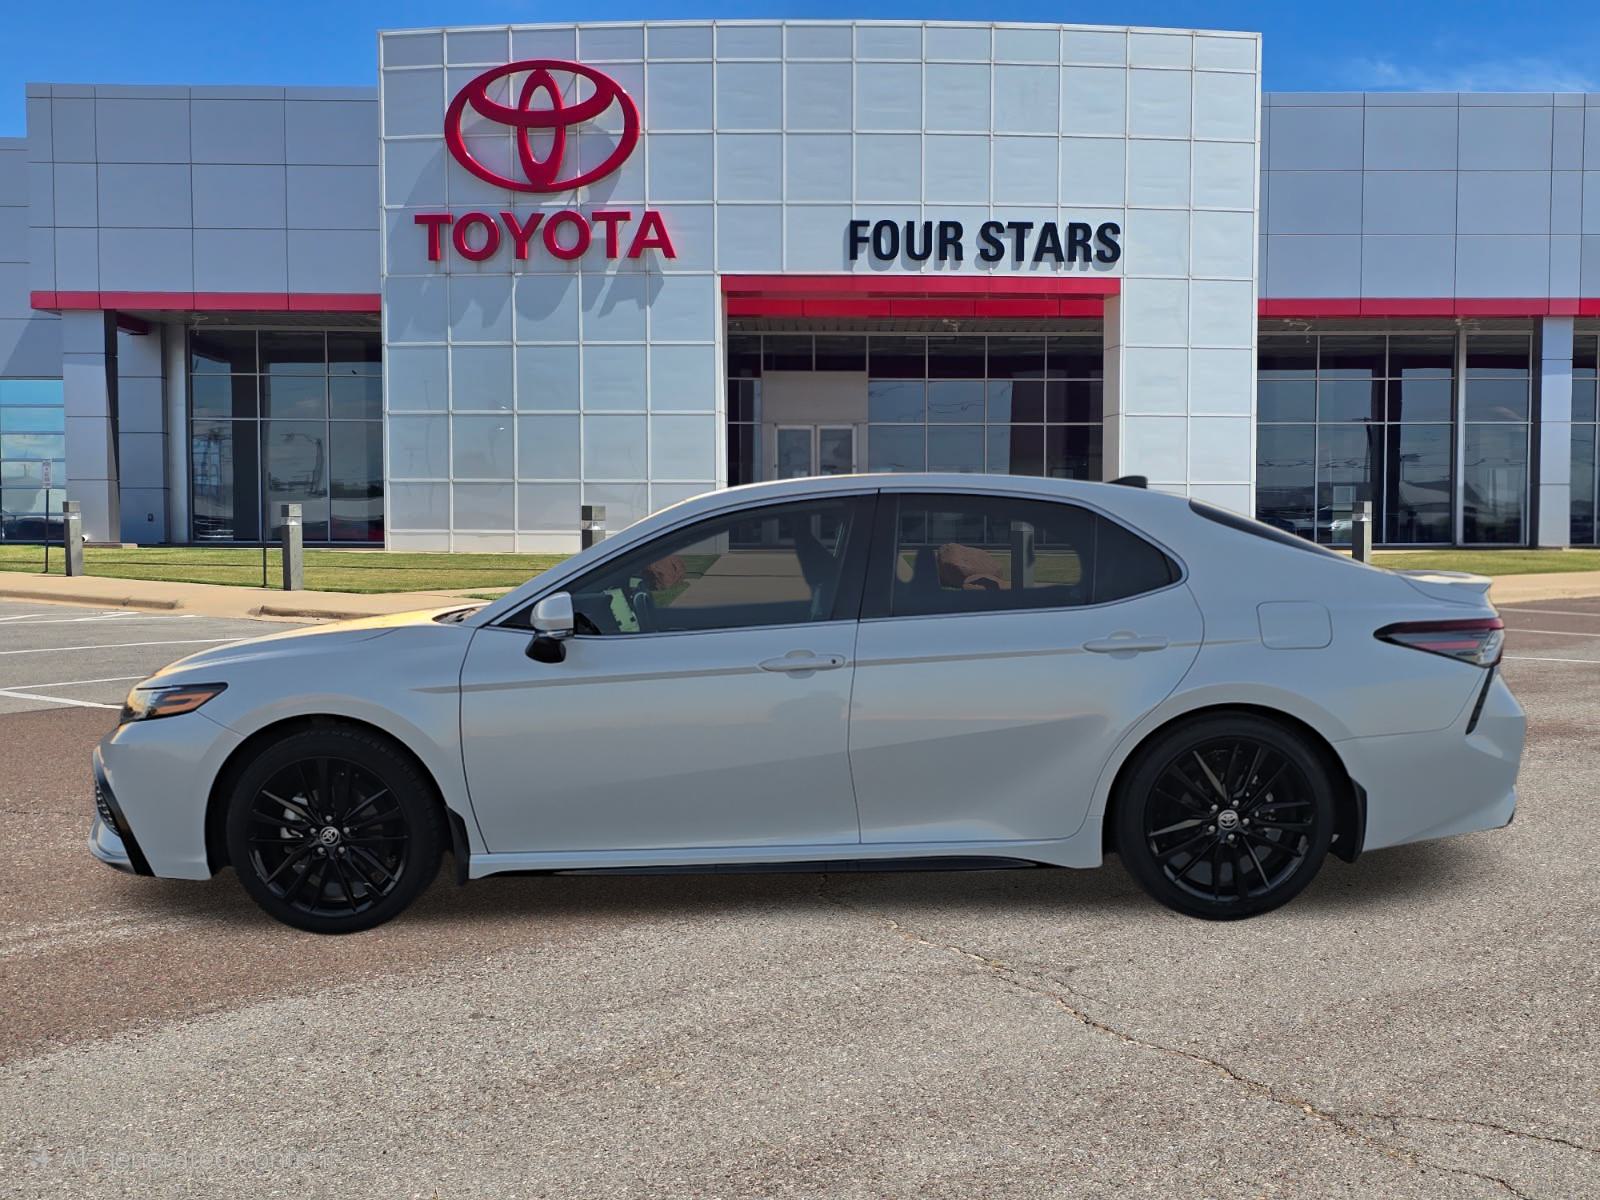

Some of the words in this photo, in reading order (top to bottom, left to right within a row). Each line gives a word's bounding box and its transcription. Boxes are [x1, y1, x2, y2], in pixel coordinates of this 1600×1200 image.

[414, 210, 677, 262] TOYOTA
[849, 219, 964, 262] FOUR
[979, 220, 1121, 264] STARS
